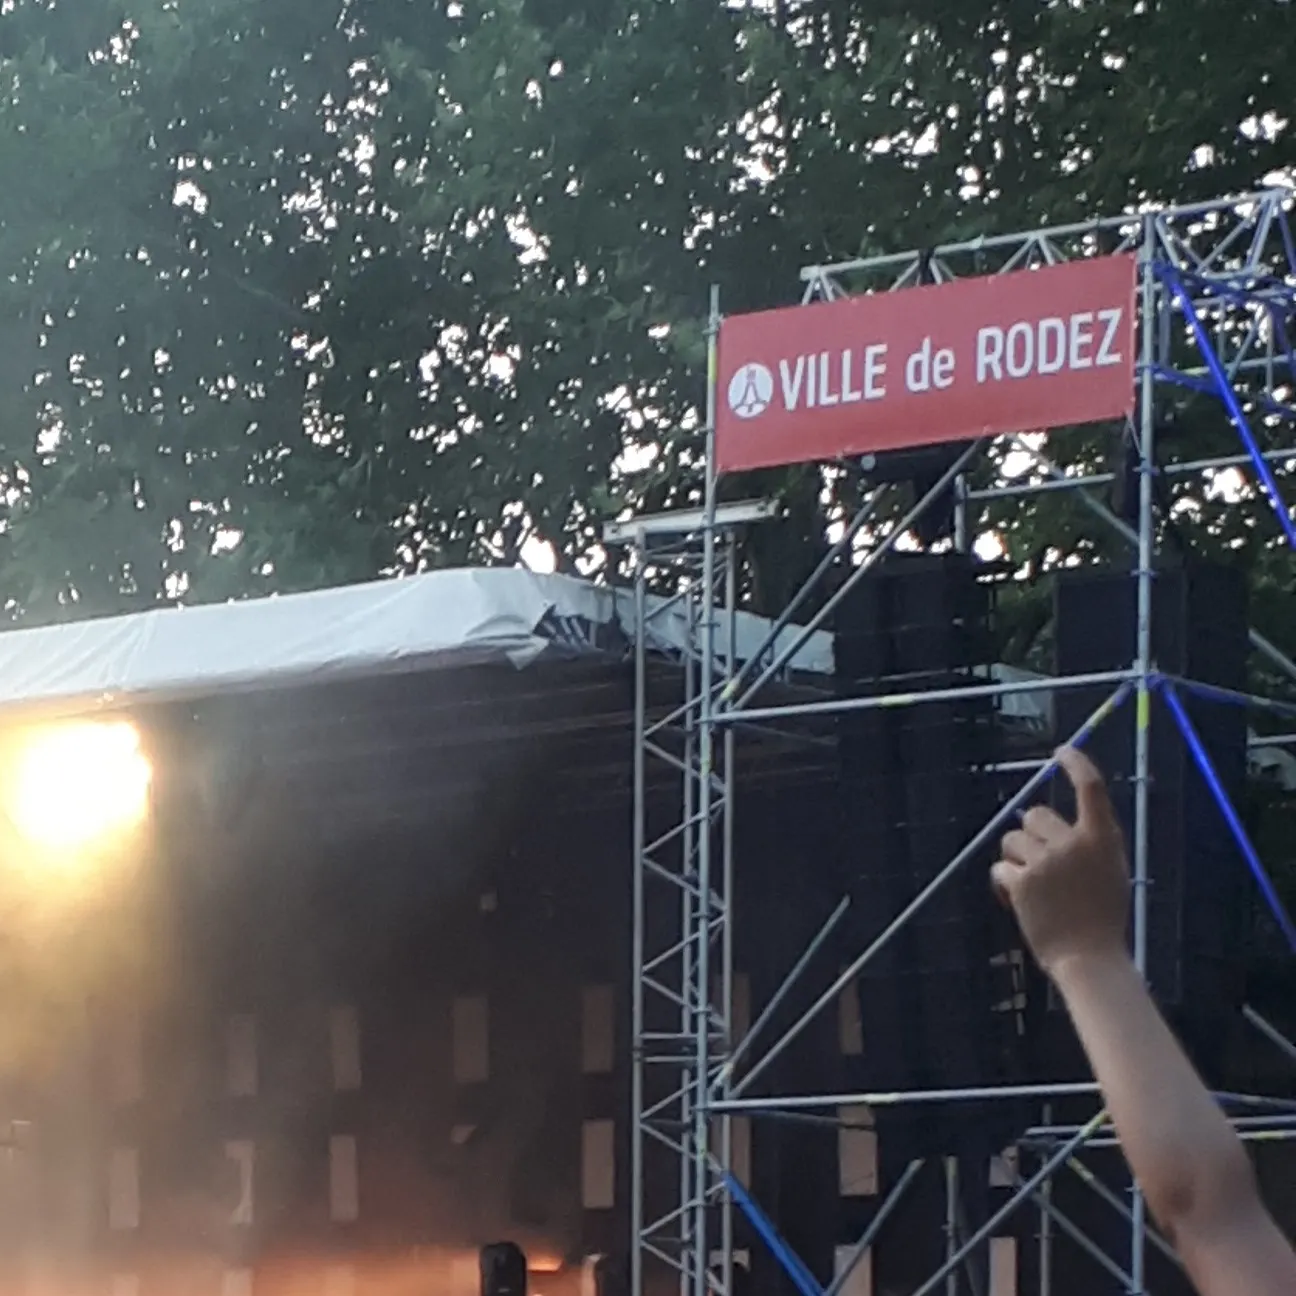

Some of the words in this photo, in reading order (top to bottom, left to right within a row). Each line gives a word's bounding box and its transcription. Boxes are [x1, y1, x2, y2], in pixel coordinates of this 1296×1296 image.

[779, 343, 888, 412] VILLE
[906, 336, 955, 392] de
[976, 308, 1123, 383] RODEZ
